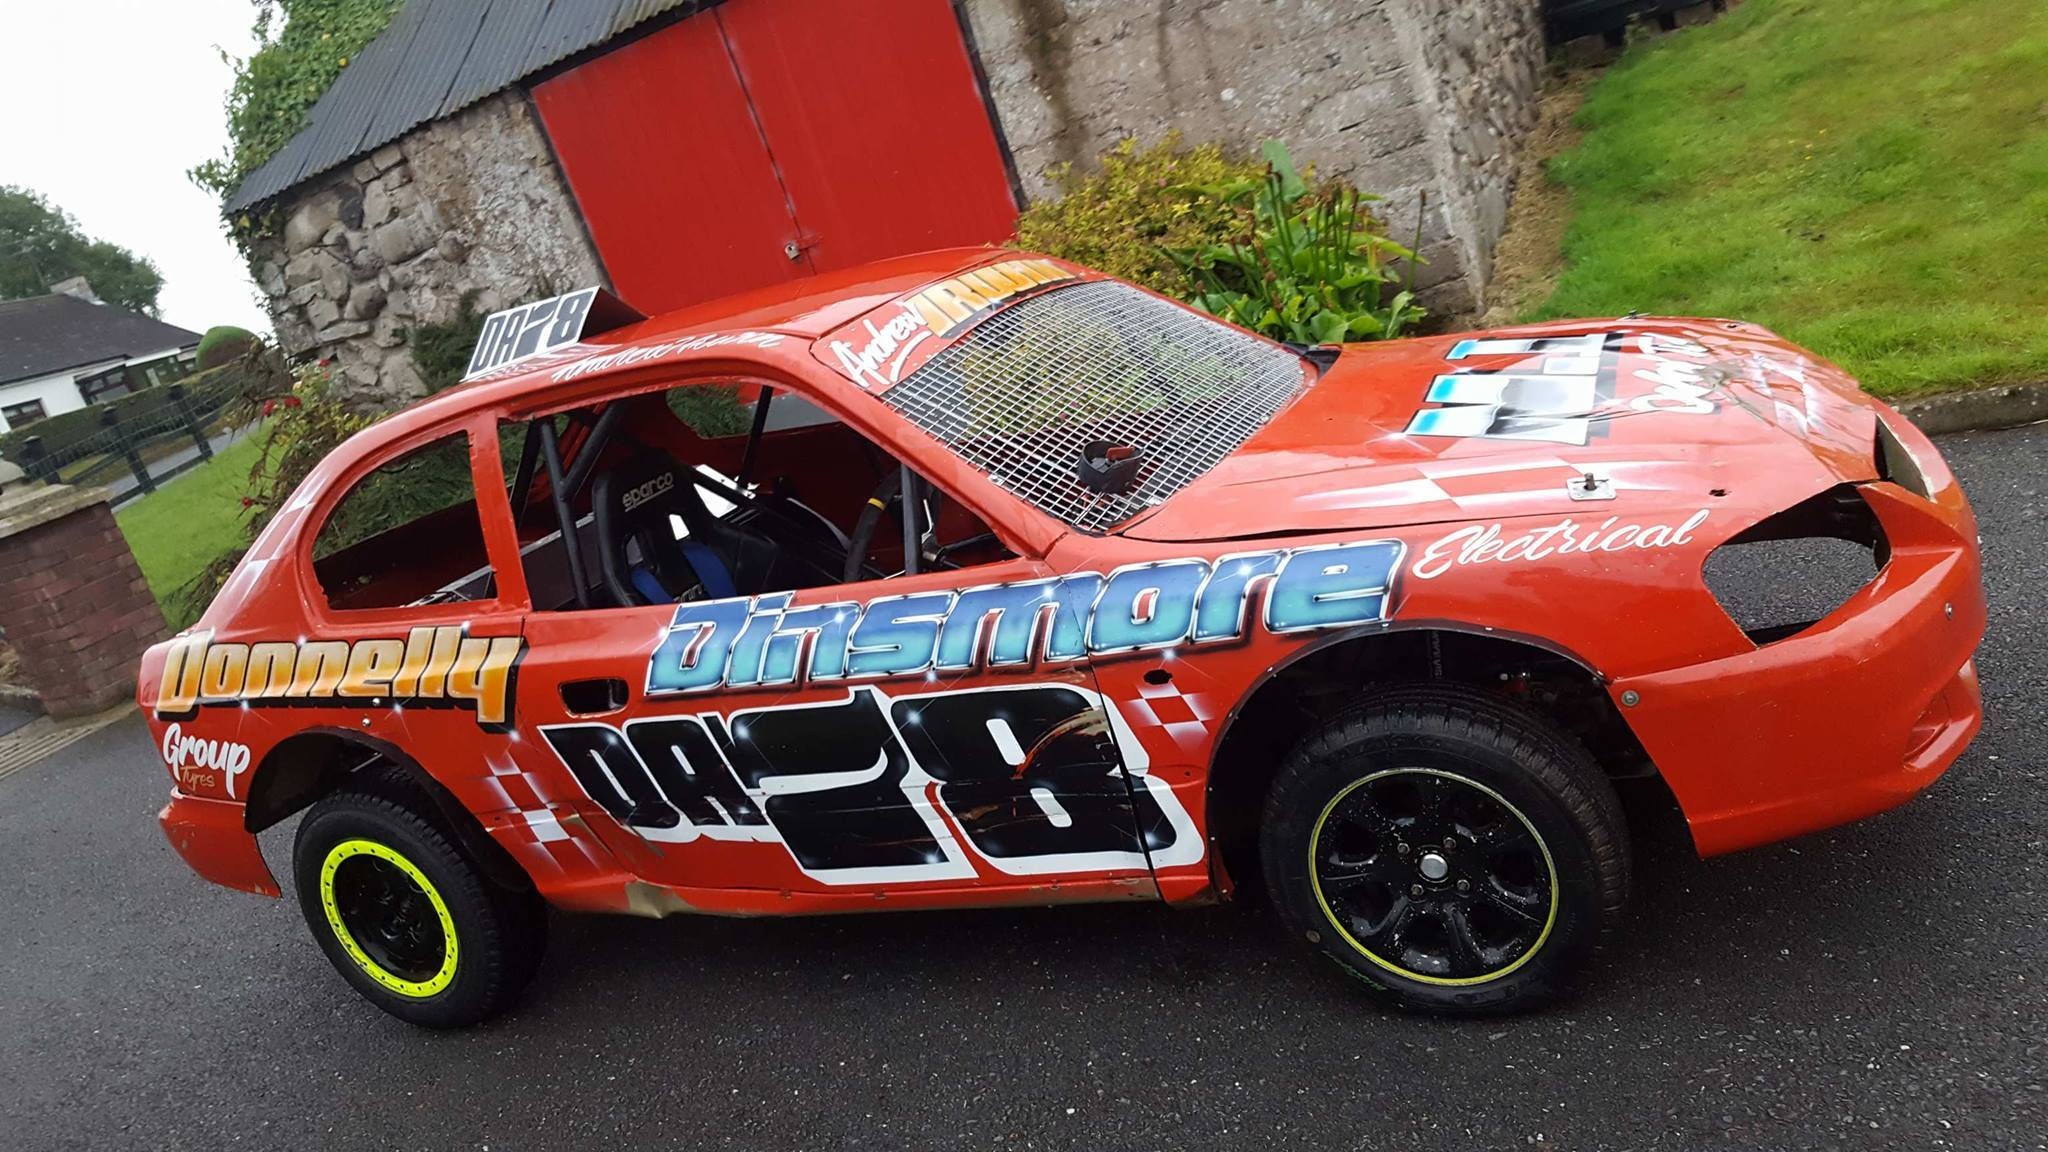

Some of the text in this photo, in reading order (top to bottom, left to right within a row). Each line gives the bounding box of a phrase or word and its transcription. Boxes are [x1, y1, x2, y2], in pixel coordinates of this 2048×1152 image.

[831, 301, 932, 388] Andrew
[621, 470, 675, 512] sparco
[644, 508, 1711, 696] Dinsmore Electrical
[155, 624, 525, 727] Donnelly
[162, 722, 251, 800] Group
[179, 764, 216, 792] Tyres
